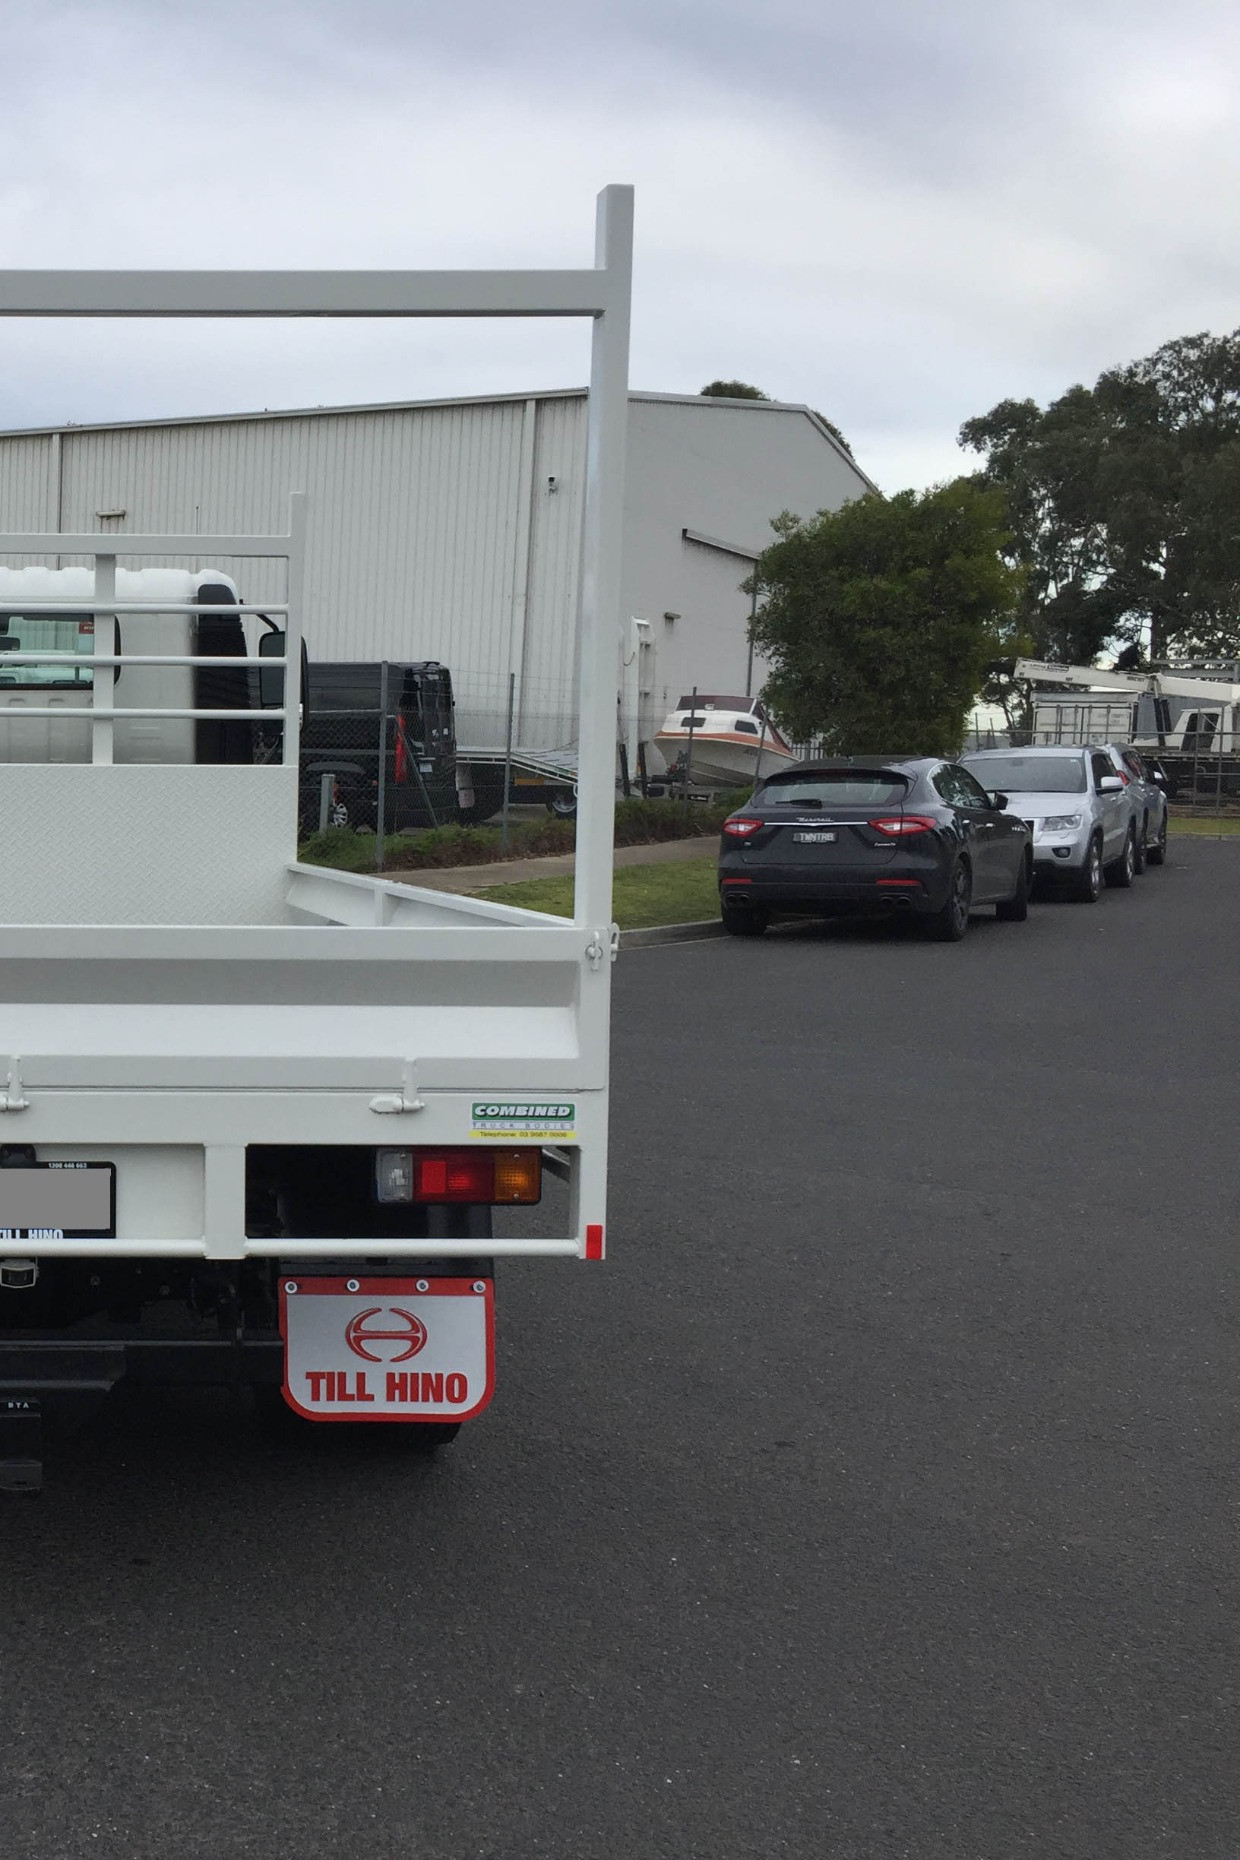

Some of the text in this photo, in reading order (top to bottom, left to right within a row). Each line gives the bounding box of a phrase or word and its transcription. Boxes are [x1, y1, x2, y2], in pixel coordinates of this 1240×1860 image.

[474, 1105, 571, 1117] COMBINED
[480, 1131, 517, 1139] Telephone:
[28, 1229, 64, 1239] HINO
[305, 1371, 468, 1404] TILL HINO
